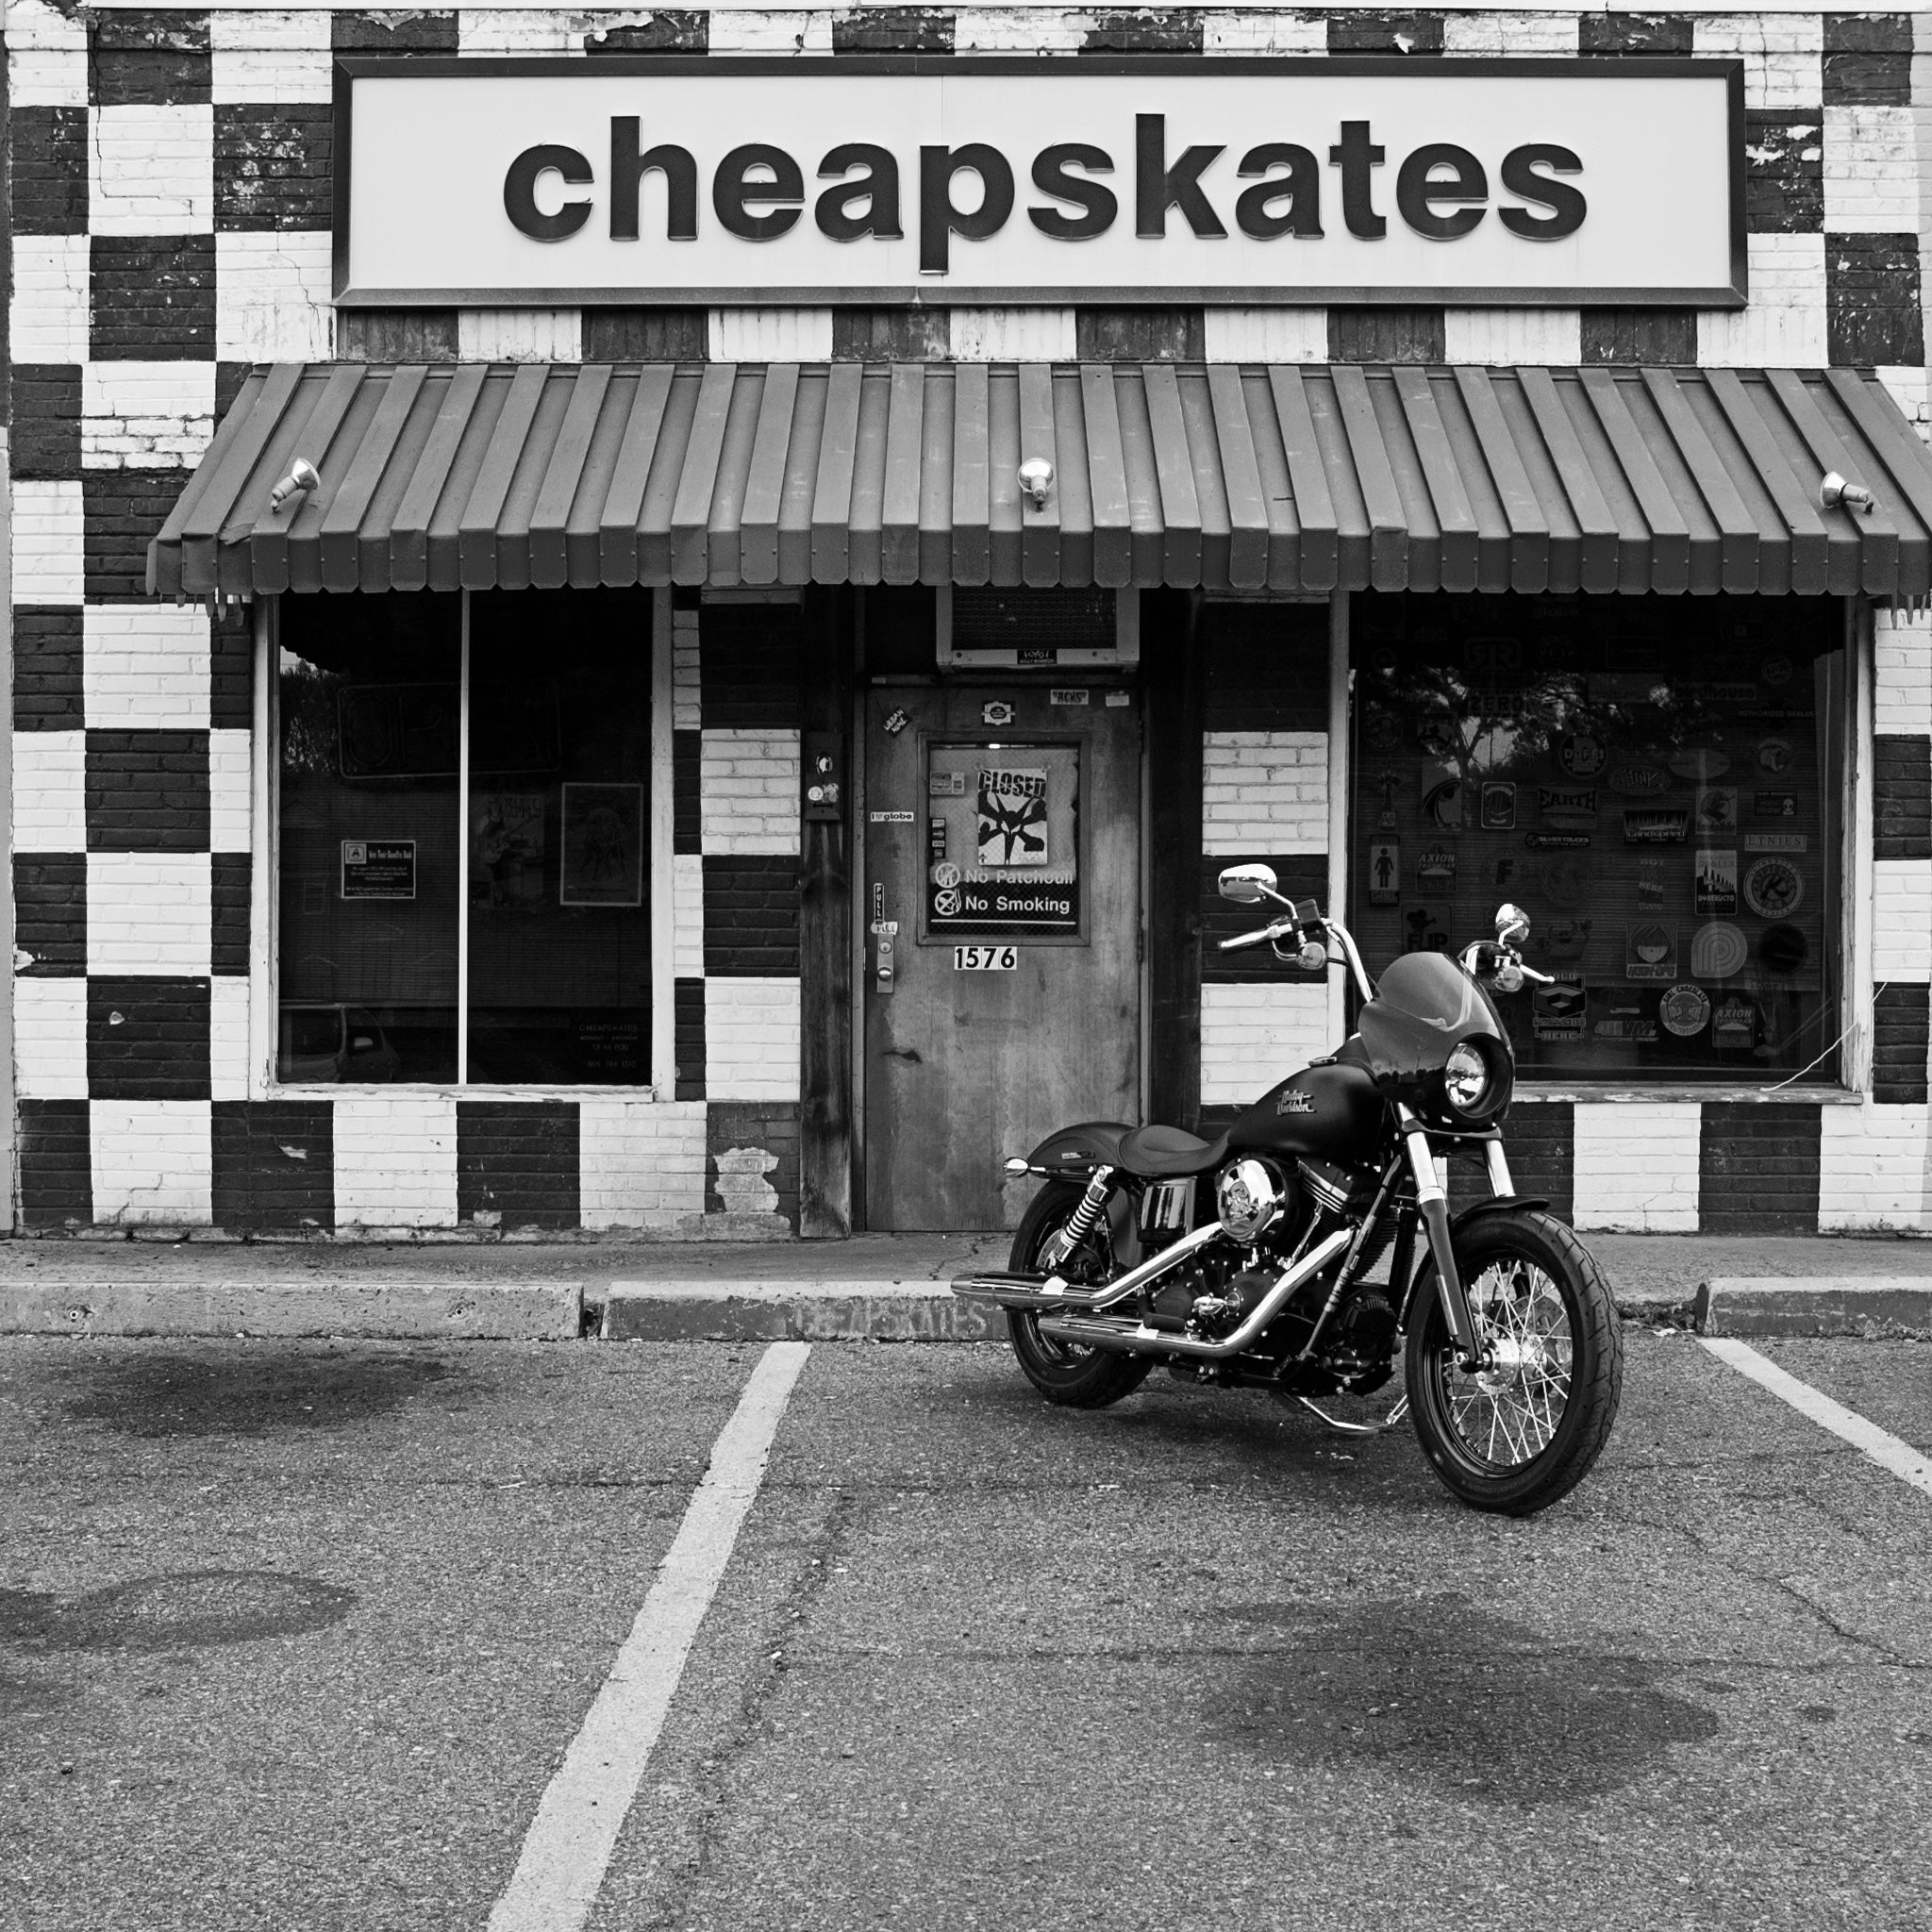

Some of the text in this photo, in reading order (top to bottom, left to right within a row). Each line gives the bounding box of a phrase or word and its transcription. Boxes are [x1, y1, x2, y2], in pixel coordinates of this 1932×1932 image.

[503, 113, 1590, 275] cheapskates
[978, 770, 1047, 800] CLOSED
[1540, 788, 1596, 812] EARTH
[884, 812, 912, 822] globe
[1418, 853, 1456, 863] AXION
[965, 870, 1073, 884] No Patchouli
[965, 896, 1070, 914] No Smoking
[955, 947, 1016, 969] 1576
[1716, 1008, 1753, 1018] AXION
